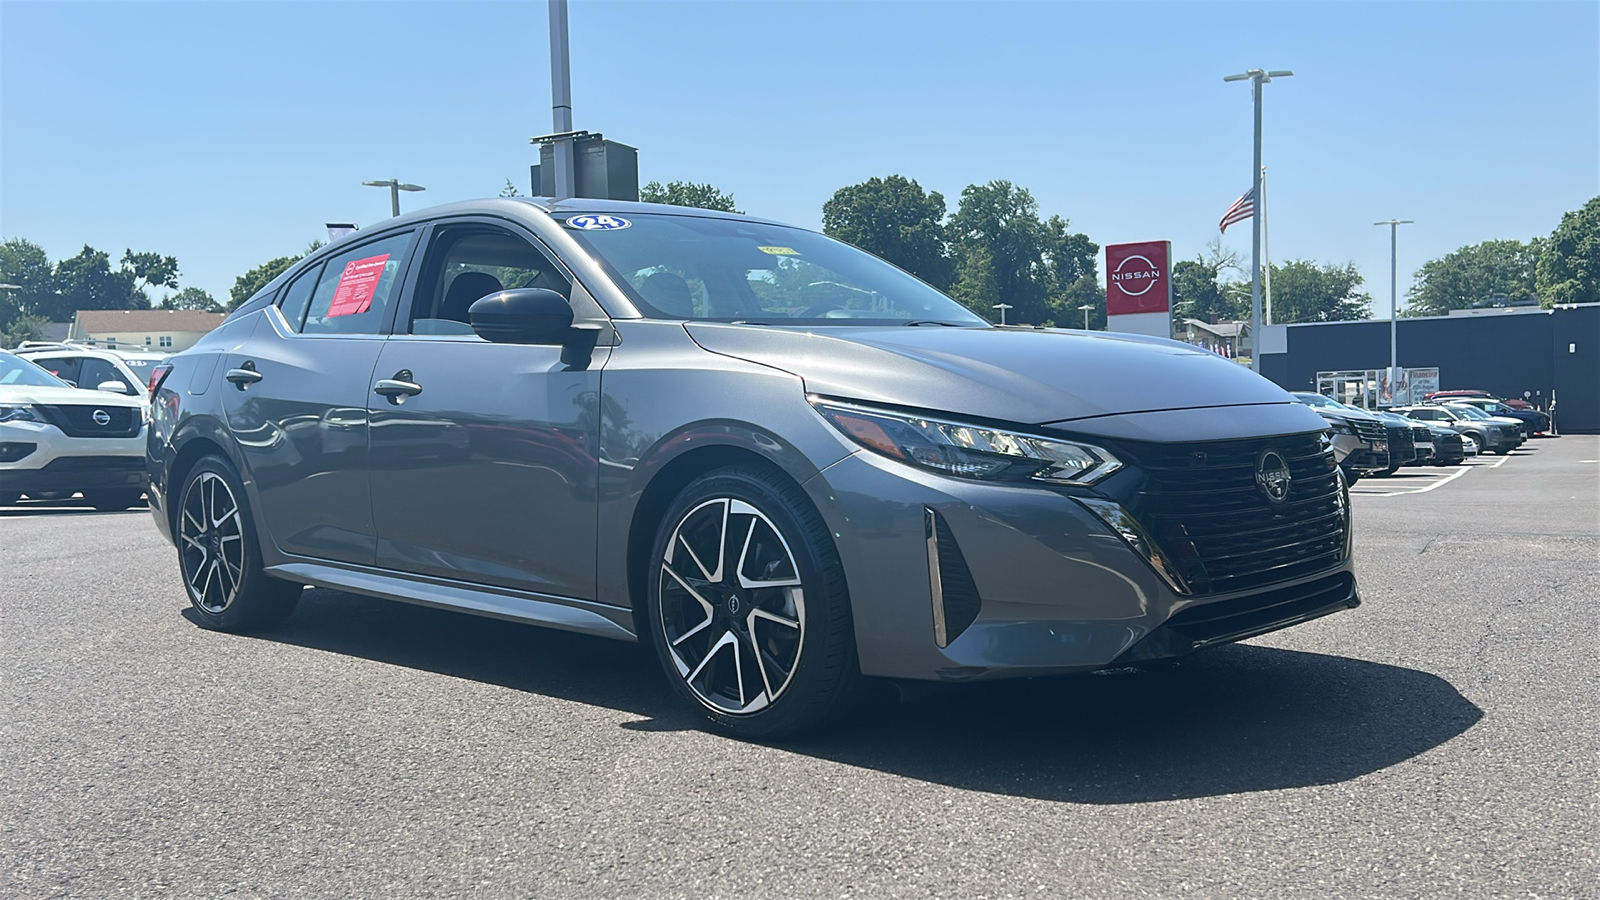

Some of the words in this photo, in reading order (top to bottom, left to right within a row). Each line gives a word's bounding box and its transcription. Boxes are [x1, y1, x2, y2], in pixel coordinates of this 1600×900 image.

[577, 216, 619, 229] 24
[1112, 270, 1159, 280] NISSAN
[1258, 470, 1290, 482] NISSAN
